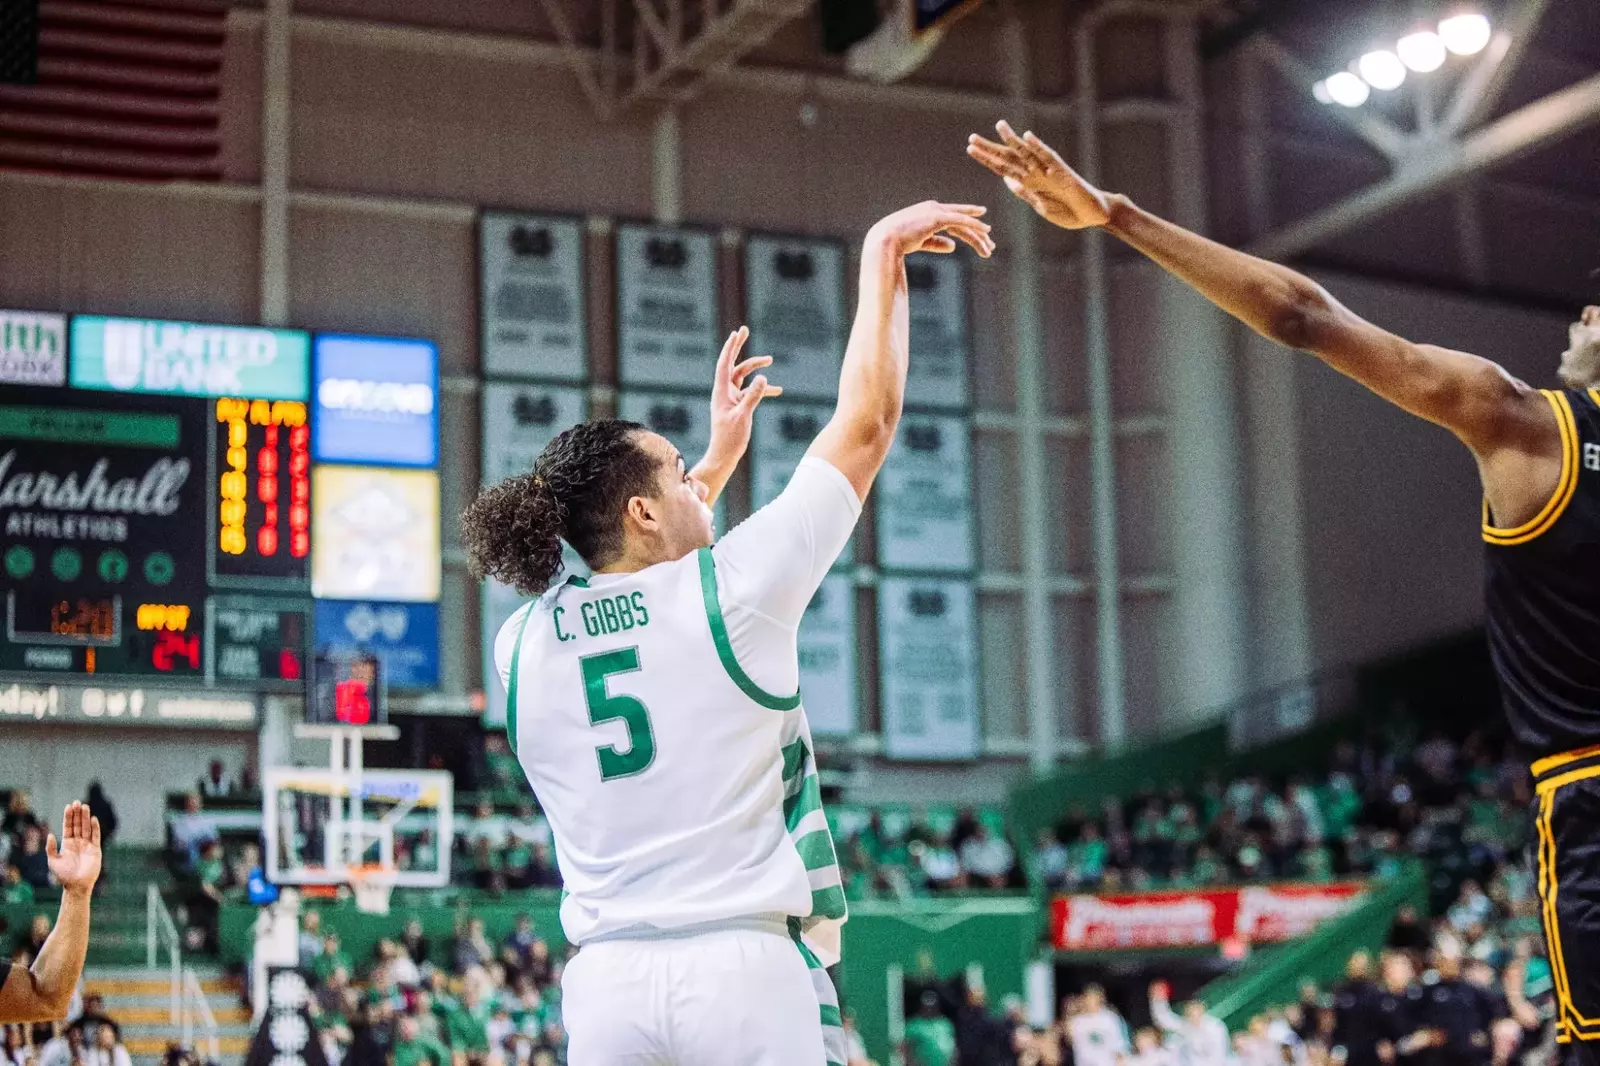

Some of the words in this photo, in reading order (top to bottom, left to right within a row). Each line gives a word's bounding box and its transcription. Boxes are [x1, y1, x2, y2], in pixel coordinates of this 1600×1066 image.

[144, 320, 277, 367] UNITED
[143, 353, 242, 395] BANK
[6, 511, 128, 542] ATHLETICS
[553, 605, 577, 642] C.
[580, 591, 650, 637] GIBBS
[578, 644, 657, 782] 5
